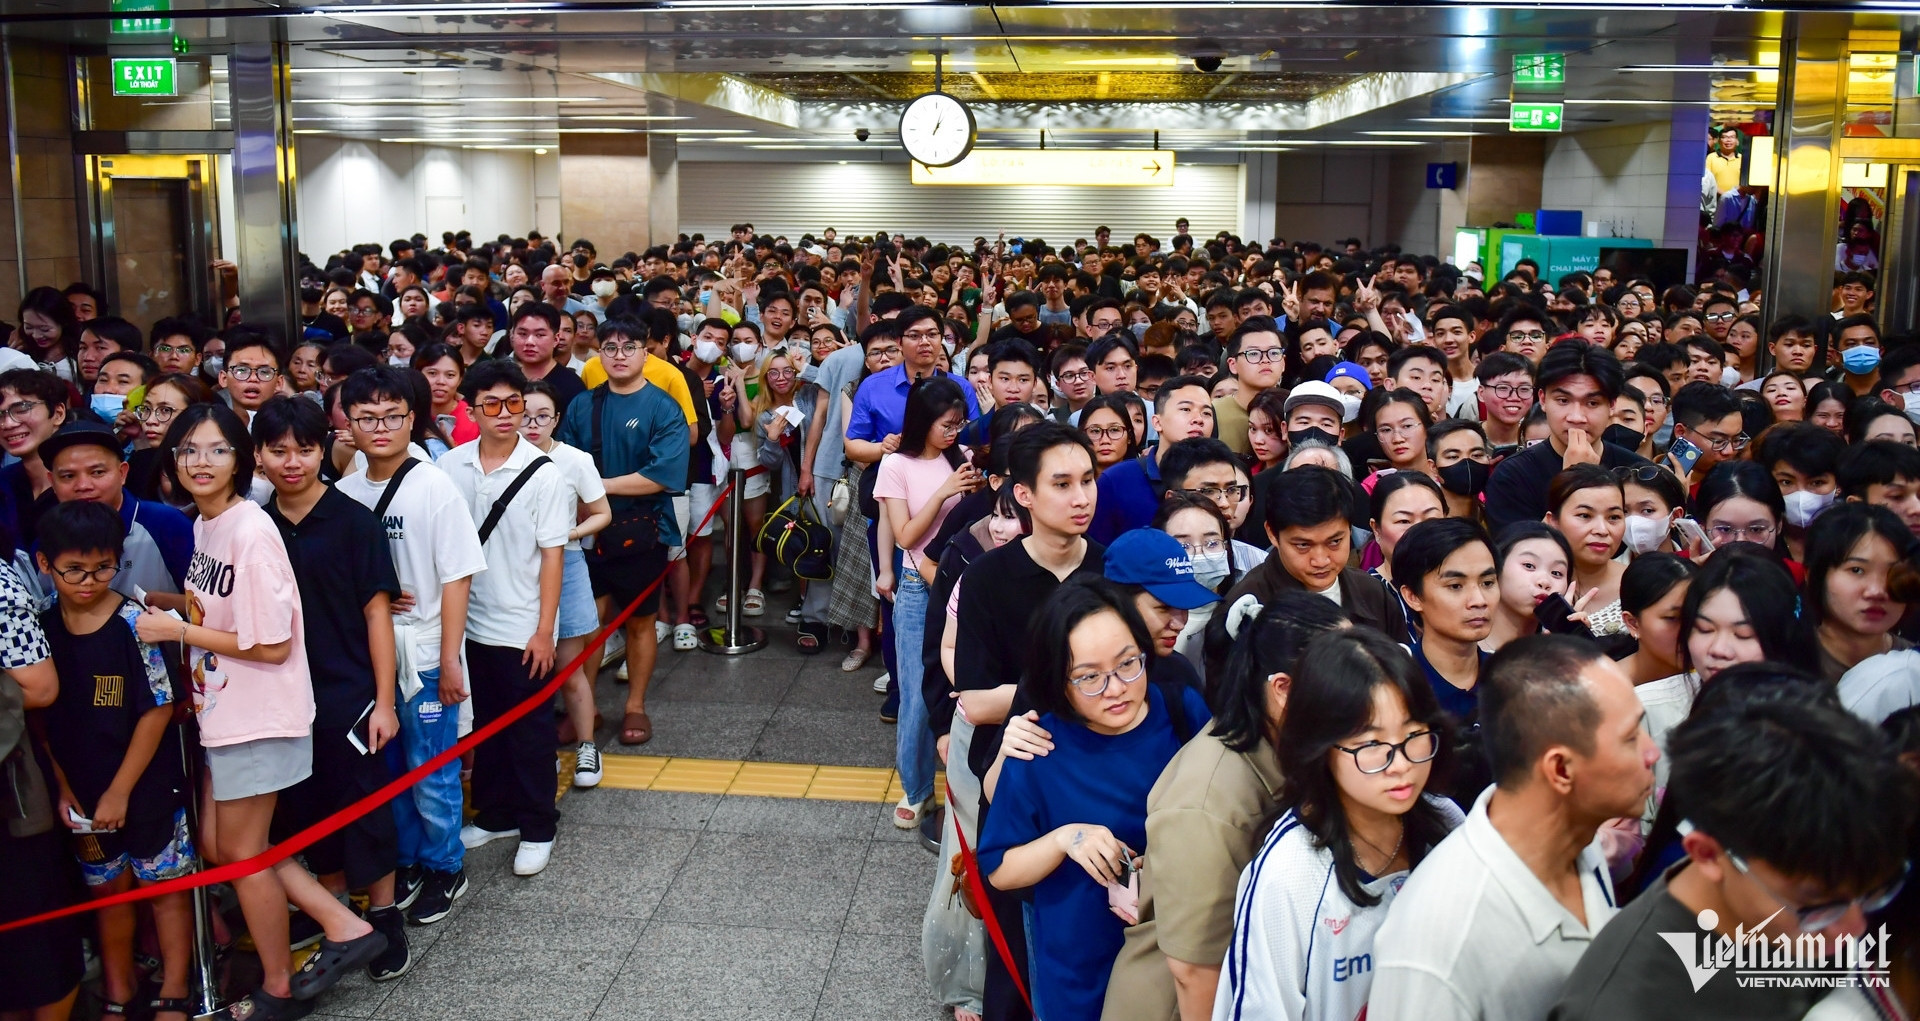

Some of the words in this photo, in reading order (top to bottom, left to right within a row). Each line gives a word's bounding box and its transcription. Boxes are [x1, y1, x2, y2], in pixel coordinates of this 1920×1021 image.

[124, 66, 163, 80] EXIT
[1550, 264, 1571, 272] CHAI
[388, 531, 404, 540] ACE
[1333, 953, 1372, 982] Em
